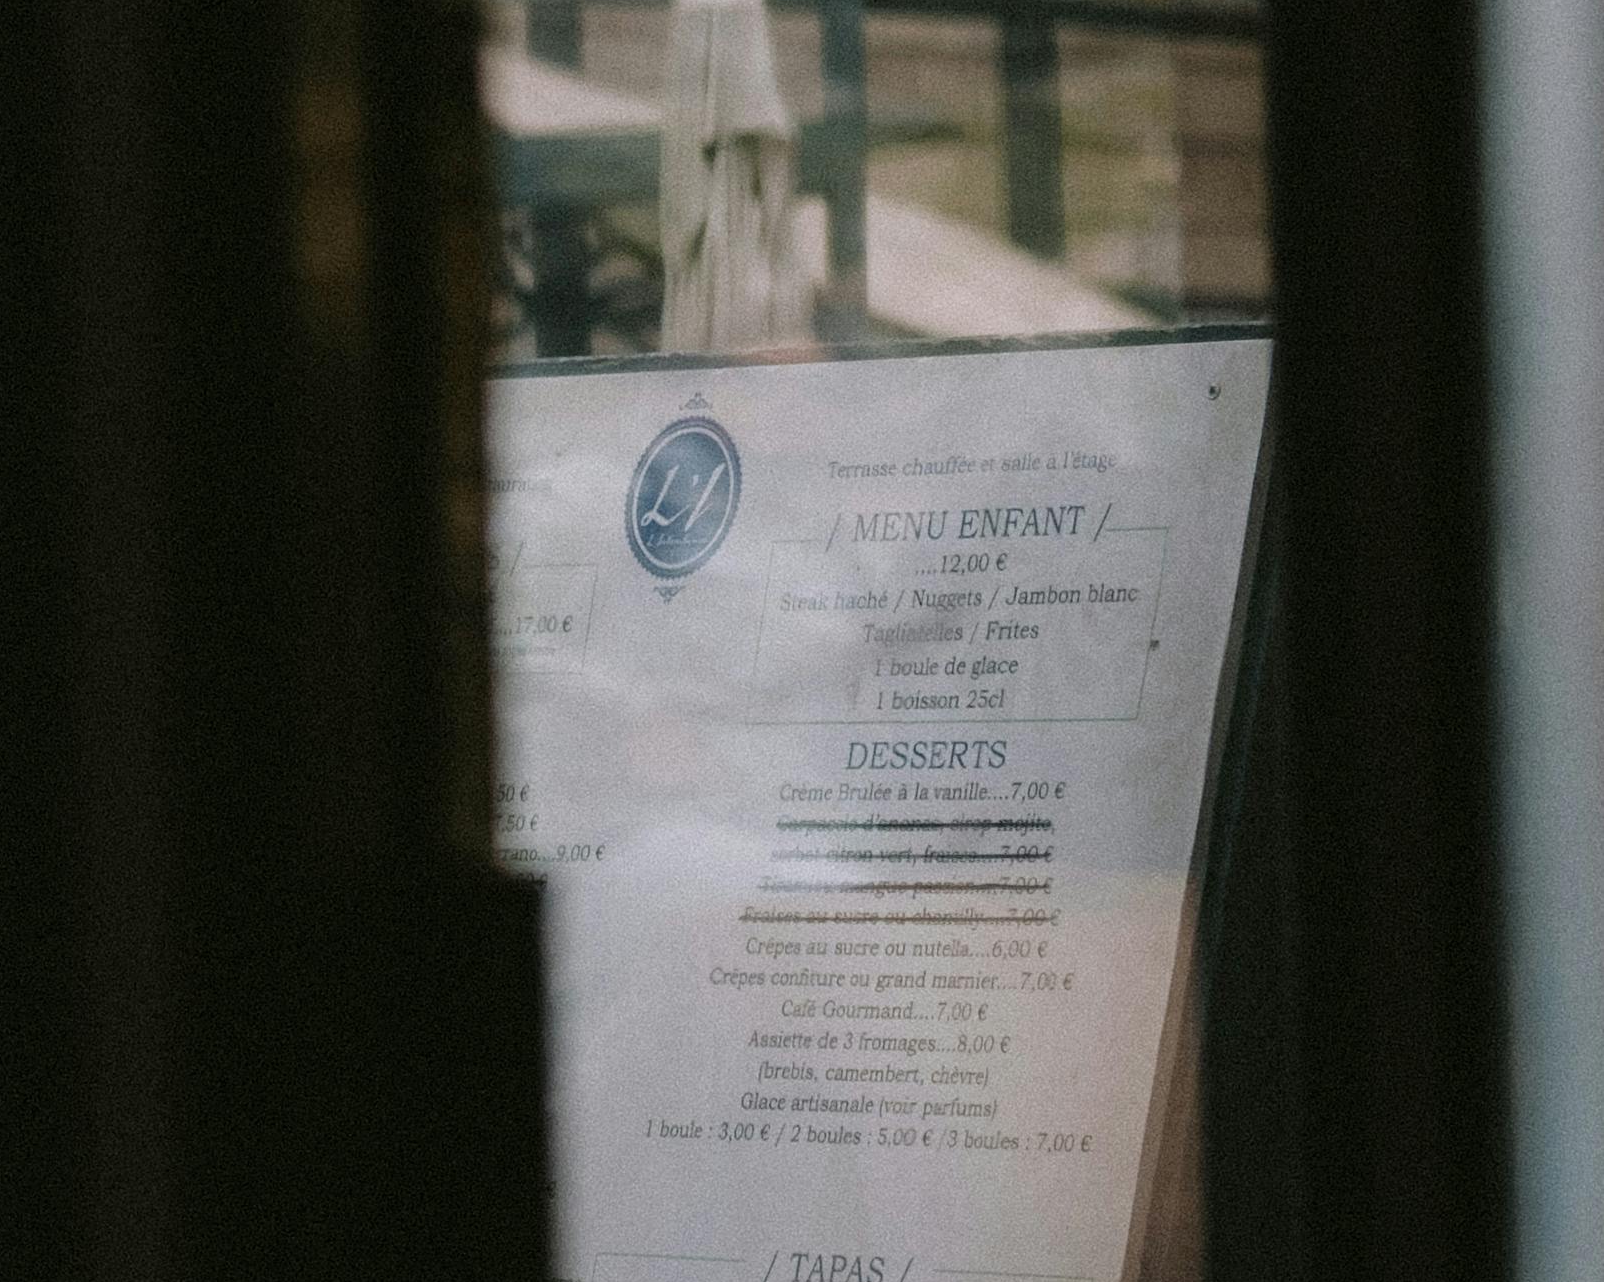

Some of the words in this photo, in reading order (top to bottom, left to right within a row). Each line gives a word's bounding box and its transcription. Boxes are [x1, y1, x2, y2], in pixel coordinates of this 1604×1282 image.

[828, 459, 896, 479] Terrasse
[902, 456, 976, 476] chauffée
[1001, 454, 1043, 472] salle
[1063, 451, 1116, 474] l'étage
[852, 510, 948, 542] MENU
[957, 505, 1085, 539] ENFANT
[780, 592, 827, 611] Steak
[835, 590, 888, 610] haché
[911, 587, 982, 612] Nuggets
[1005, 585, 1081, 605] Jambon
[1088, 583, 1138, 603] blanc
[985, 620, 1039, 640] Frites
[890, 656, 938, 676] boule
[944, 656, 966, 675] de
[971, 654, 1018, 678] glace
[892, 690, 959, 709] boisson
[966, 689, 1005, 708] 25cl
[845, 740, 1007, 769] DESSERTS
[779, 781, 832, 800] Crème
[897, 781, 908, 800] à
[914, 781, 928, 800] la
[806, 943, 827, 955] au
[834, 943, 879, 956] sucre
[885, 943, 906, 956] ou
[771, 969, 845, 988] confiture
[850, 976, 870, 989] ou
[875, 970, 926, 994] grand
[781, 998, 816, 1018] Café
[748, 1030, 812, 1050] Assiette
[817, 1031, 838, 1050] de
[843, 1032, 853, 1051] 3
[758, 1061, 818, 1085] (brebis,
[825, 1062, 924, 1088] camembert,
[931, 1065, 989, 1090] chèvre)
[740, 1091, 785, 1111] Glace
[791, 1093, 874, 1113] artisanale
[879, 1094, 916, 1119] (voir
[922, 1096, 998, 1121] parfums)
[660, 1120, 703, 1140] boule
[717, 1122, 755, 1146] 3,00
[790, 1124, 801, 1143] 2
[806, 1125, 861, 1145] boules
[877, 1127, 917, 1151] 5,00
[963, 1130, 1019, 1150] boules
[1036, 1132, 1074, 1156] 7,00
